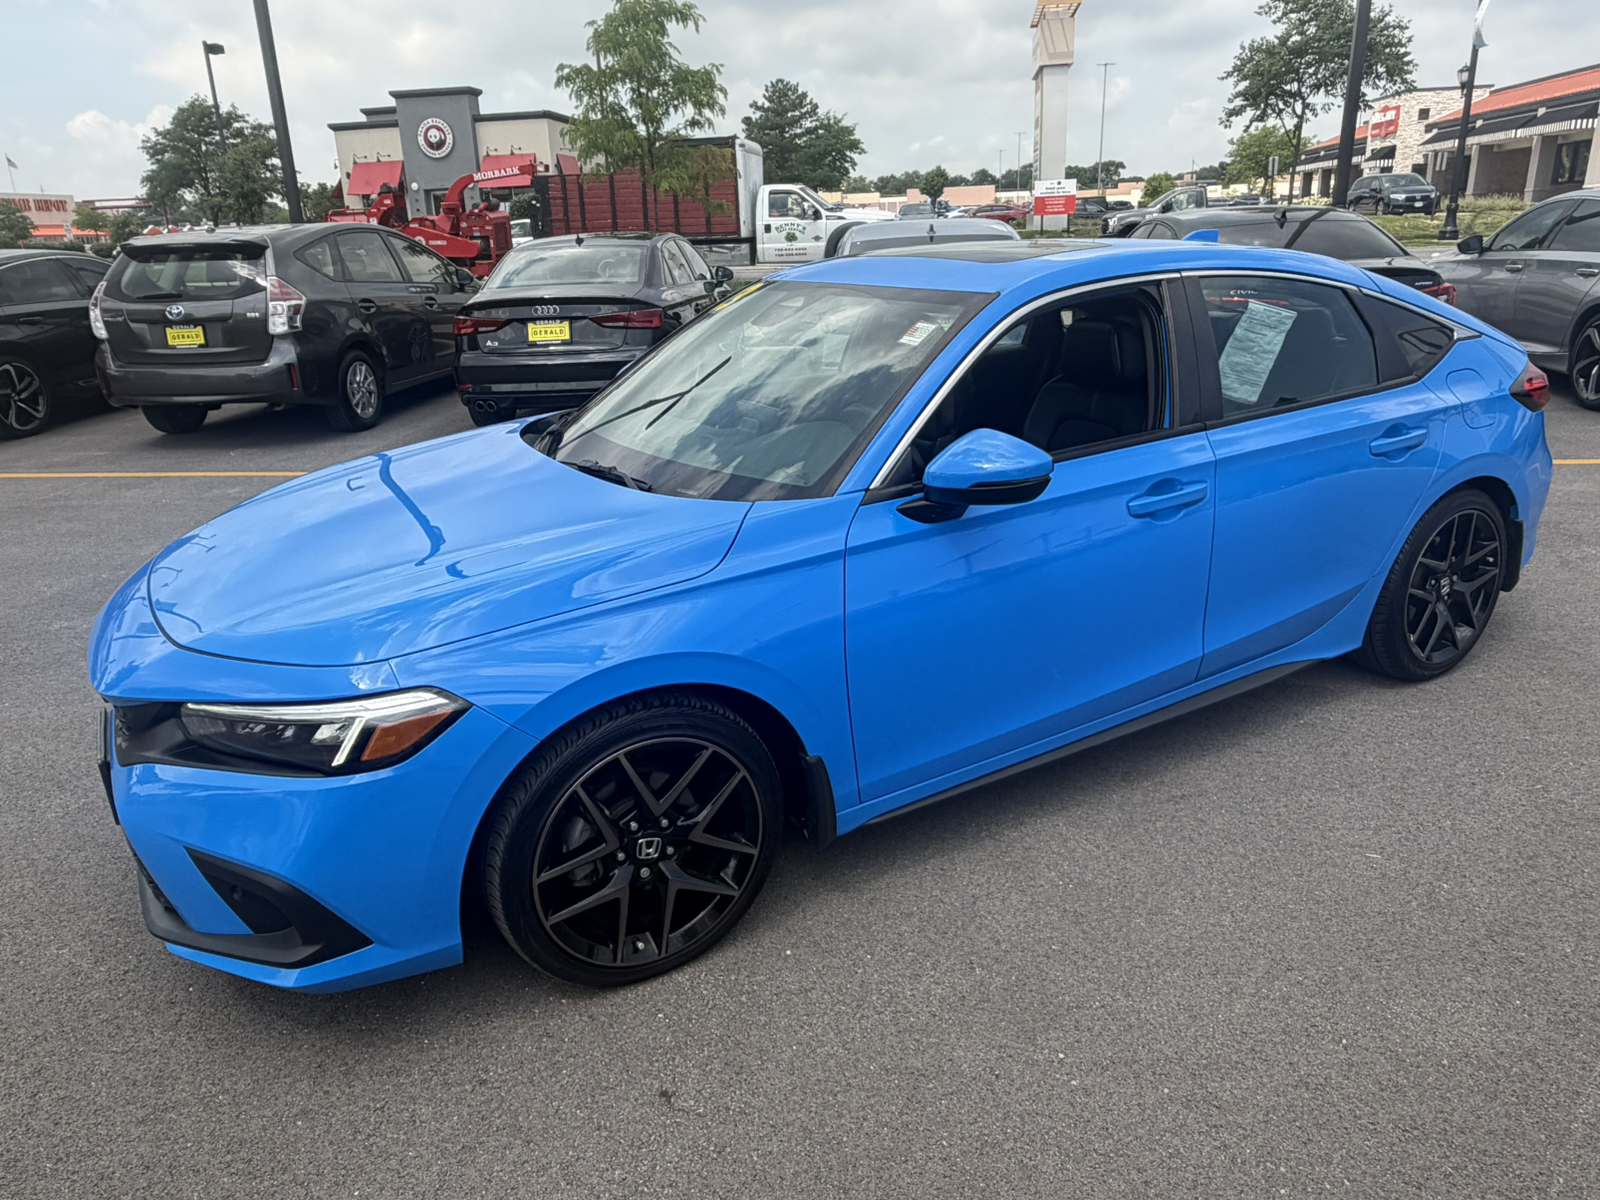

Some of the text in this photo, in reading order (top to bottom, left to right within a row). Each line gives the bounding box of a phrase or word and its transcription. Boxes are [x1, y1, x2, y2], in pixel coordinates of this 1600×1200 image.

[418, 120, 431, 138] PANDA
[473, 166, 520, 181] MORBARK
[533, 328, 564, 336] GERALD
[171, 333, 201, 341] GERALD
[485, 339, 499, 347] A3
